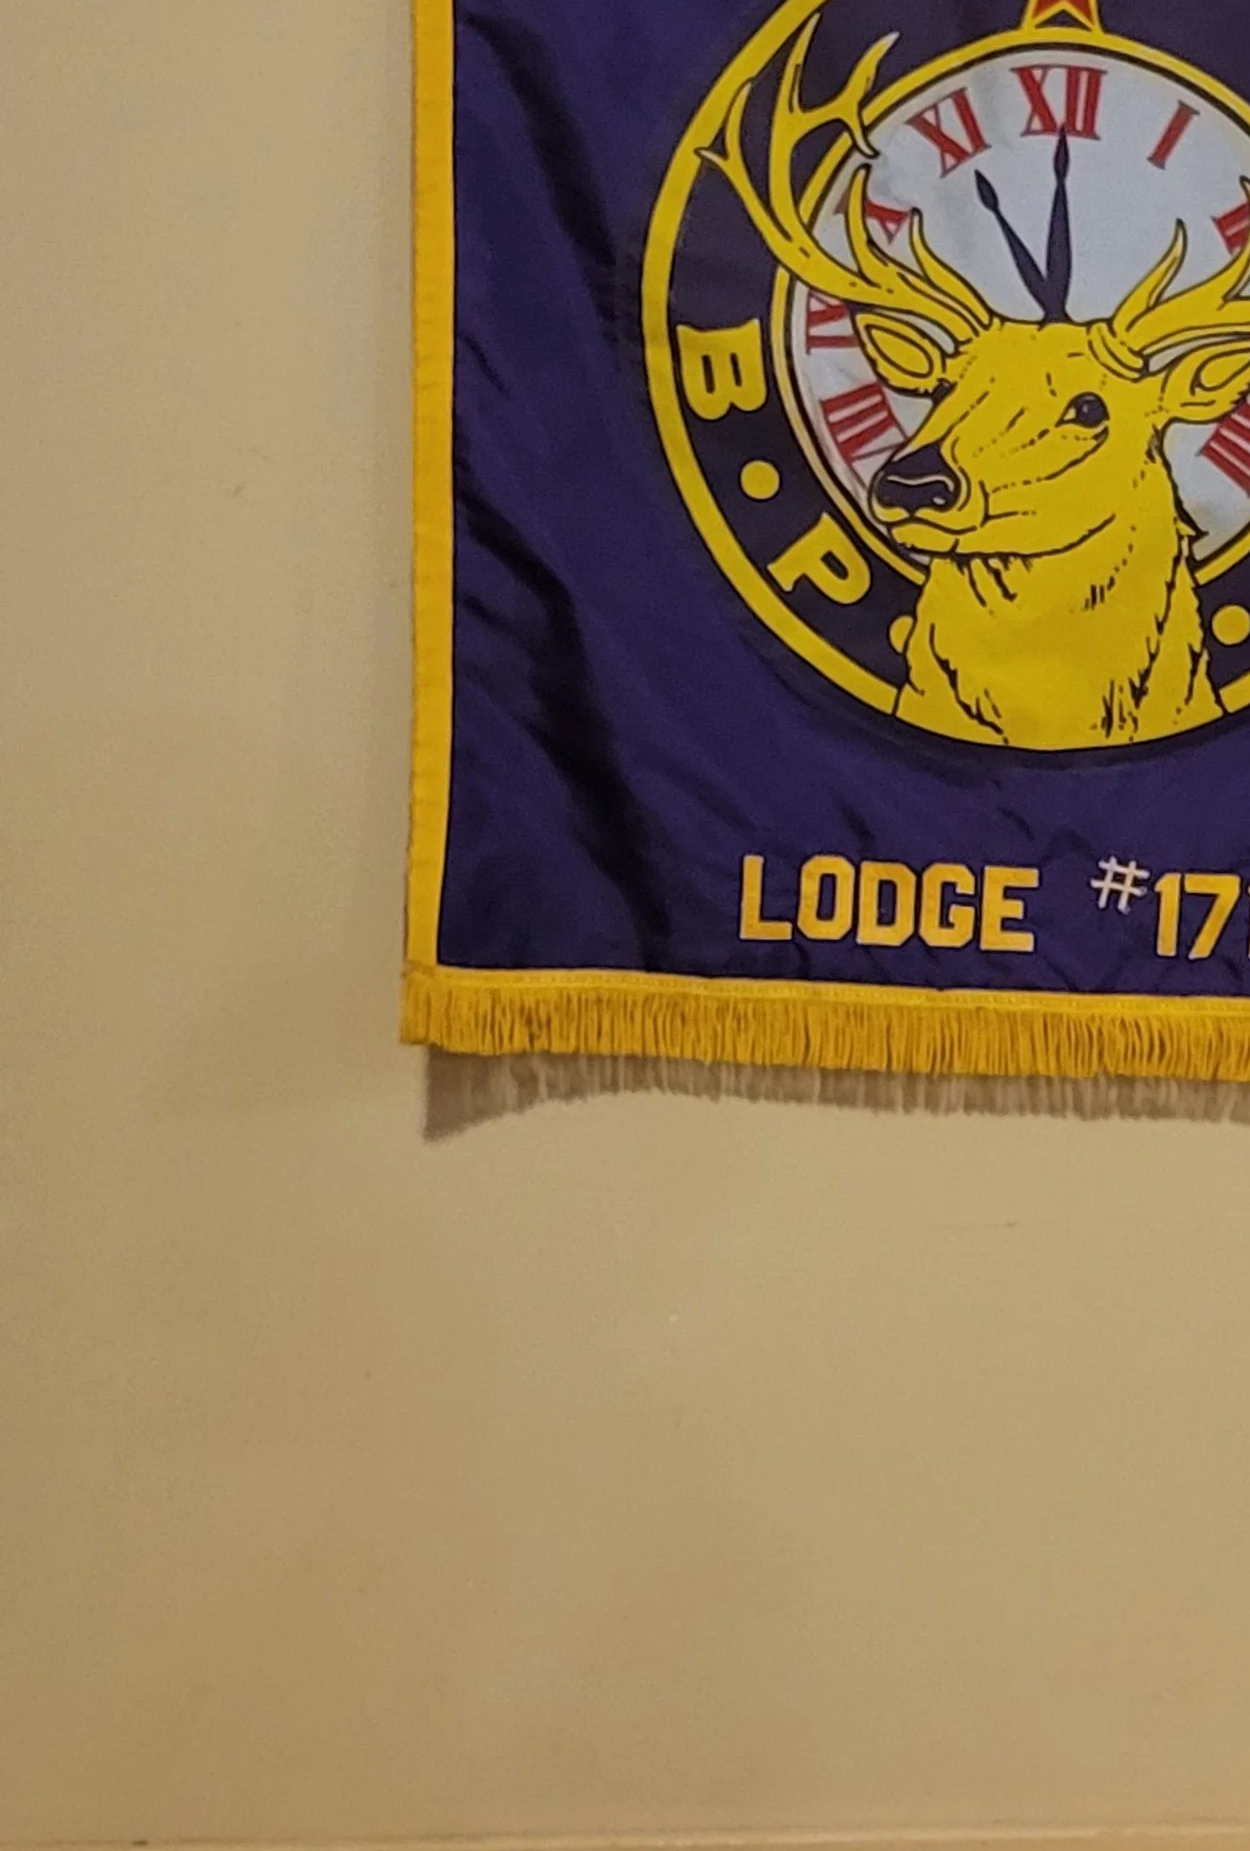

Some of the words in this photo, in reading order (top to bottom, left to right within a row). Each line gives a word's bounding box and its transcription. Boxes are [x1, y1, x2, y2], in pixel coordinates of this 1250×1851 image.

[907, 88, 991, 178] XI
[1010, 64, 1107, 139] XII
[1147, 100, 1199, 169] I
[677, 319, 769, 421] B
[767, 511, 871, 606] P
[739, 855, 1039, 952] LODGE
